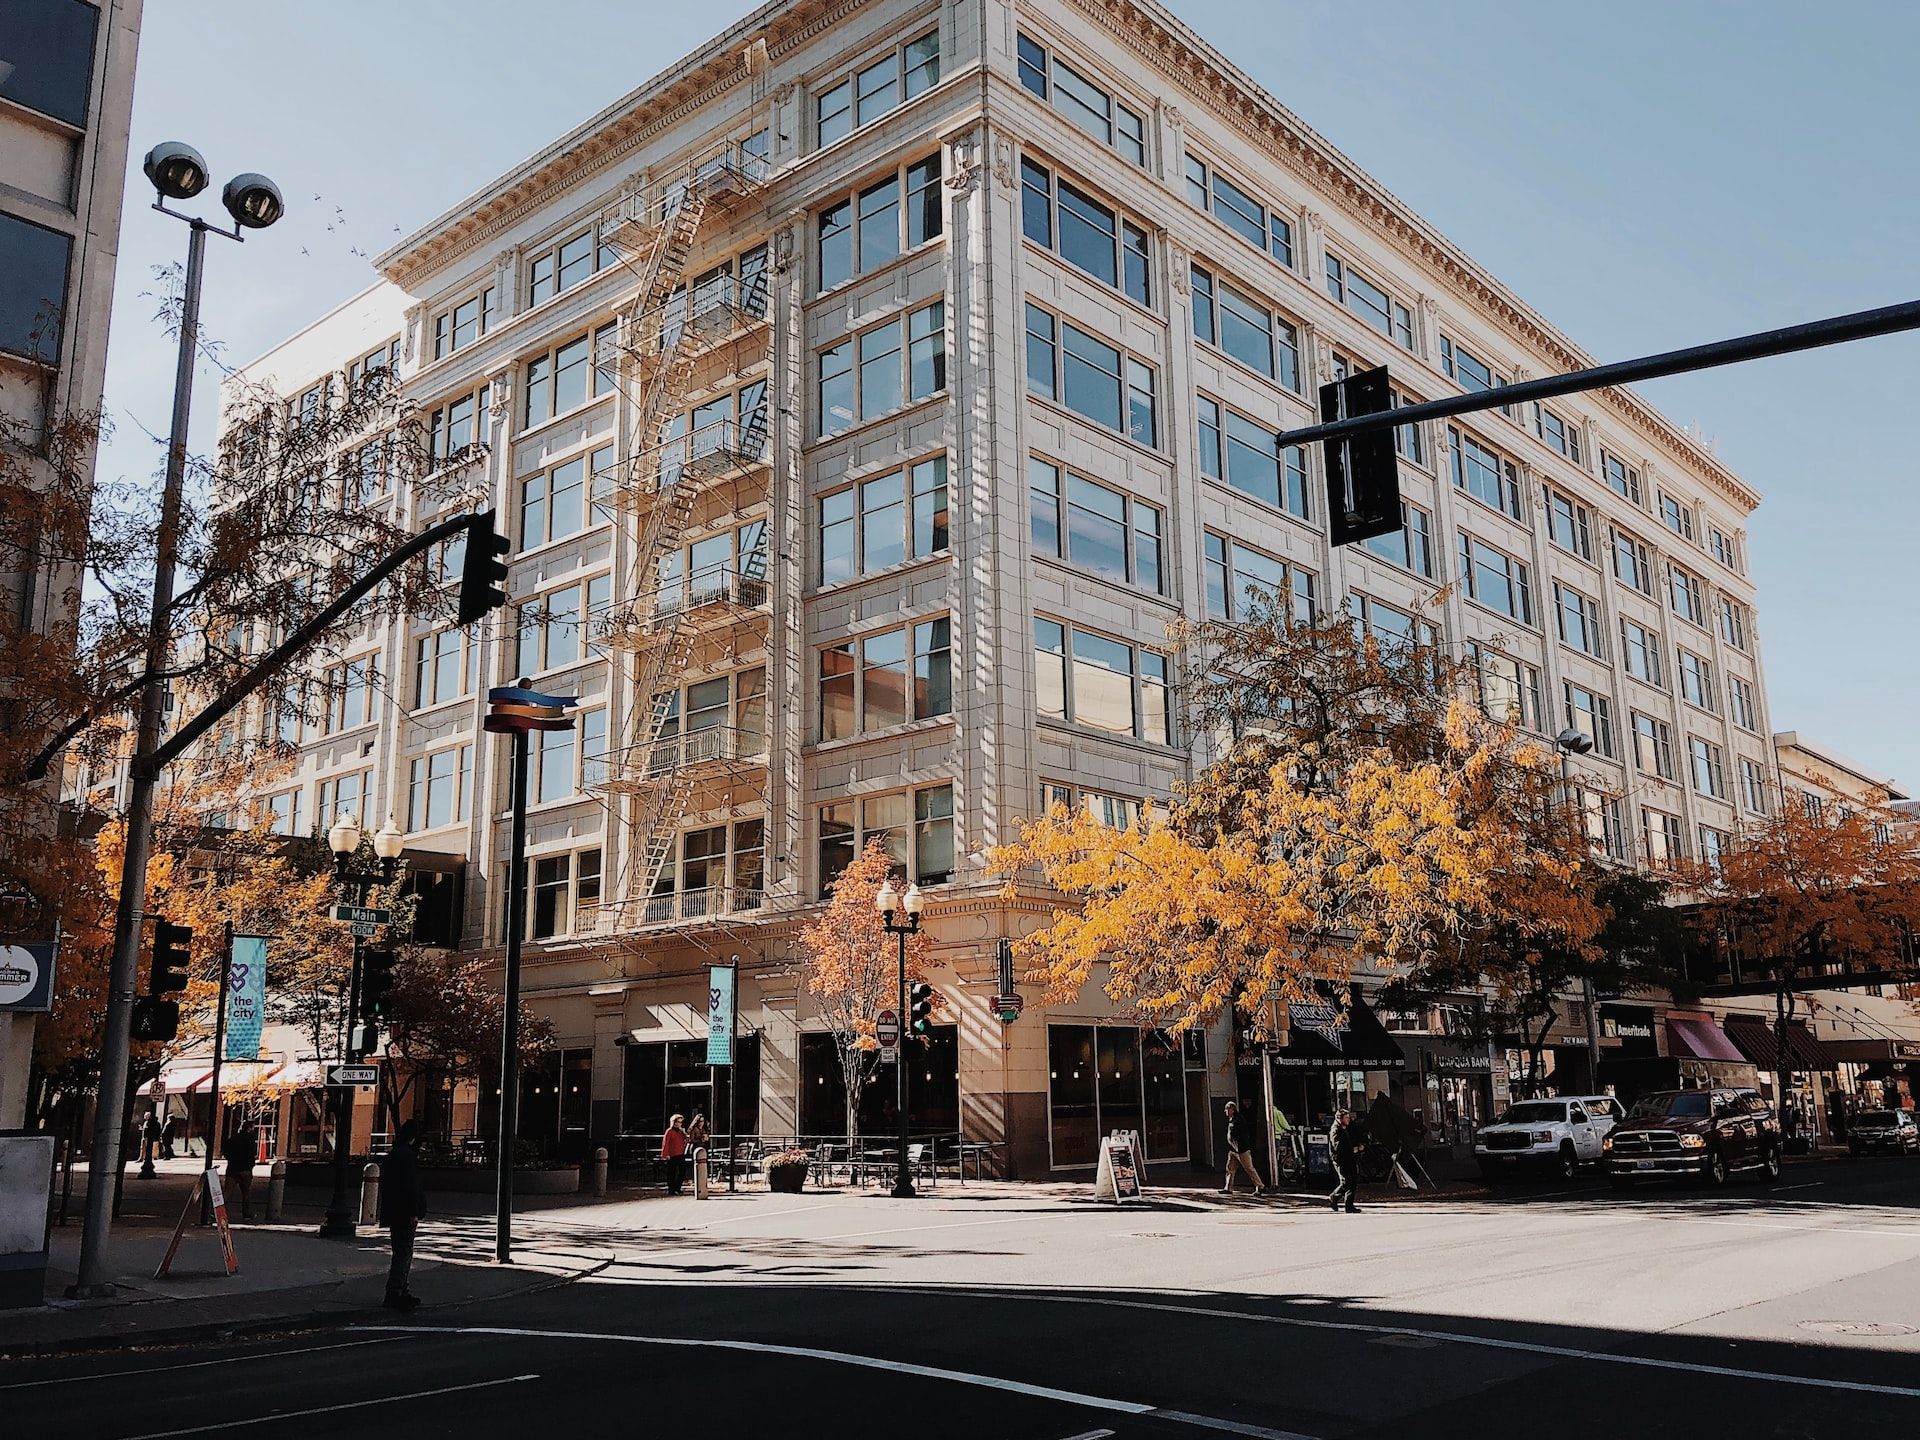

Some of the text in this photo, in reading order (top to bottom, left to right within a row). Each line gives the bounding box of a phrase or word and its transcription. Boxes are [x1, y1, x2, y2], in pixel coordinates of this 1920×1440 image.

[351, 908, 377, 921] Main
[0, 974, 28, 982] MMER
[234, 996, 252, 1006] the
[233, 1009, 255, 1020] city
[713, 1015, 724, 1023] the
[712, 1025, 725, 1034] city
[1617, 1024, 1651, 1037] Ameritrade
[880, 1033, 895, 1041] ENTER
[1471, 1056, 1490, 1068] BANK
[341, 1071, 374, 1079] ONE WAY
